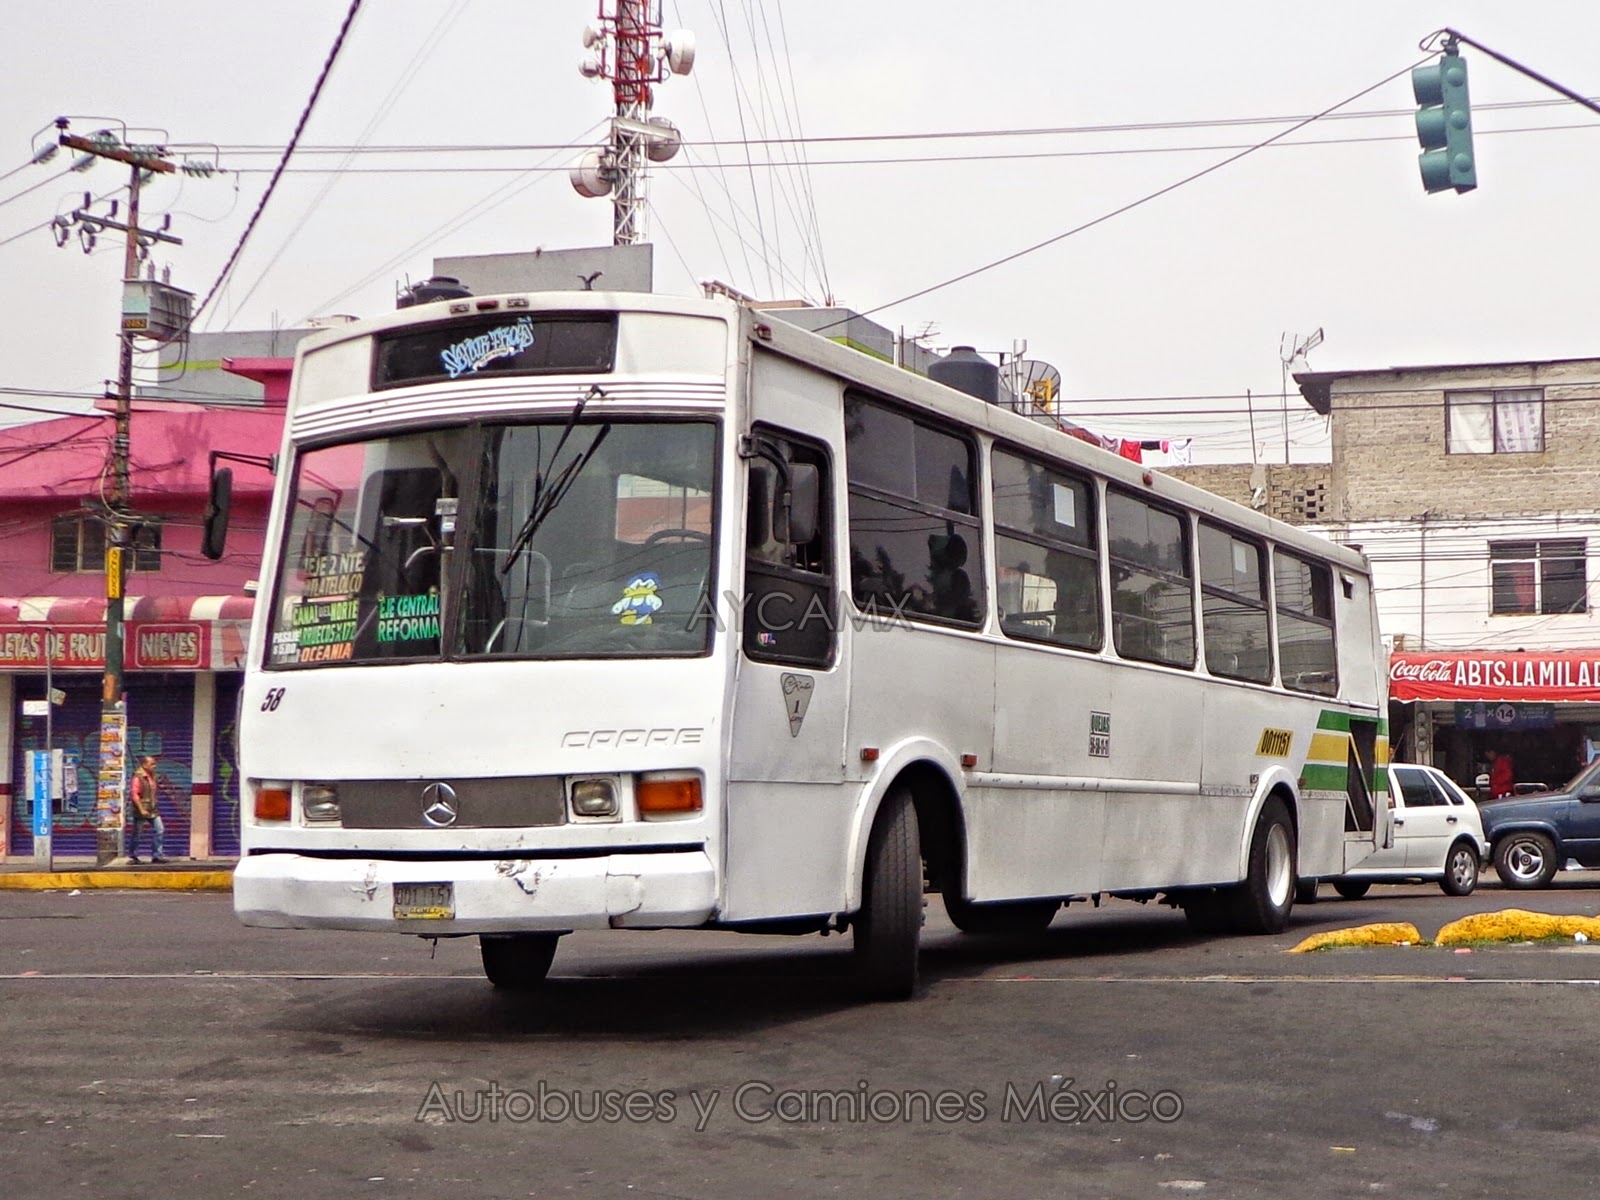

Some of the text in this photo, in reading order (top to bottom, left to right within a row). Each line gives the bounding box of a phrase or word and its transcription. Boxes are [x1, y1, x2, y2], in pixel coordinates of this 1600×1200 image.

[329, 555, 337, 575] 2
[292, 603, 320, 626] CANAL
[330, 599, 358, 621] NORTE
[379, 592, 440, 619] EJE CENTRAL
[377, 616, 442, 642] REFORMA
[45, 631, 66, 660] DE
[141, 631, 198, 661] NIEVES
[299, 642, 353, 662] OCEANIA
[1390, 660, 1454, 682] Coca-Cola
[260, 687, 286, 712] 58
[1090, 713, 1110, 734] QUEJAS
[1464, 708, 1473, 719] 2
[1499, 708, 1514, 719] 14
